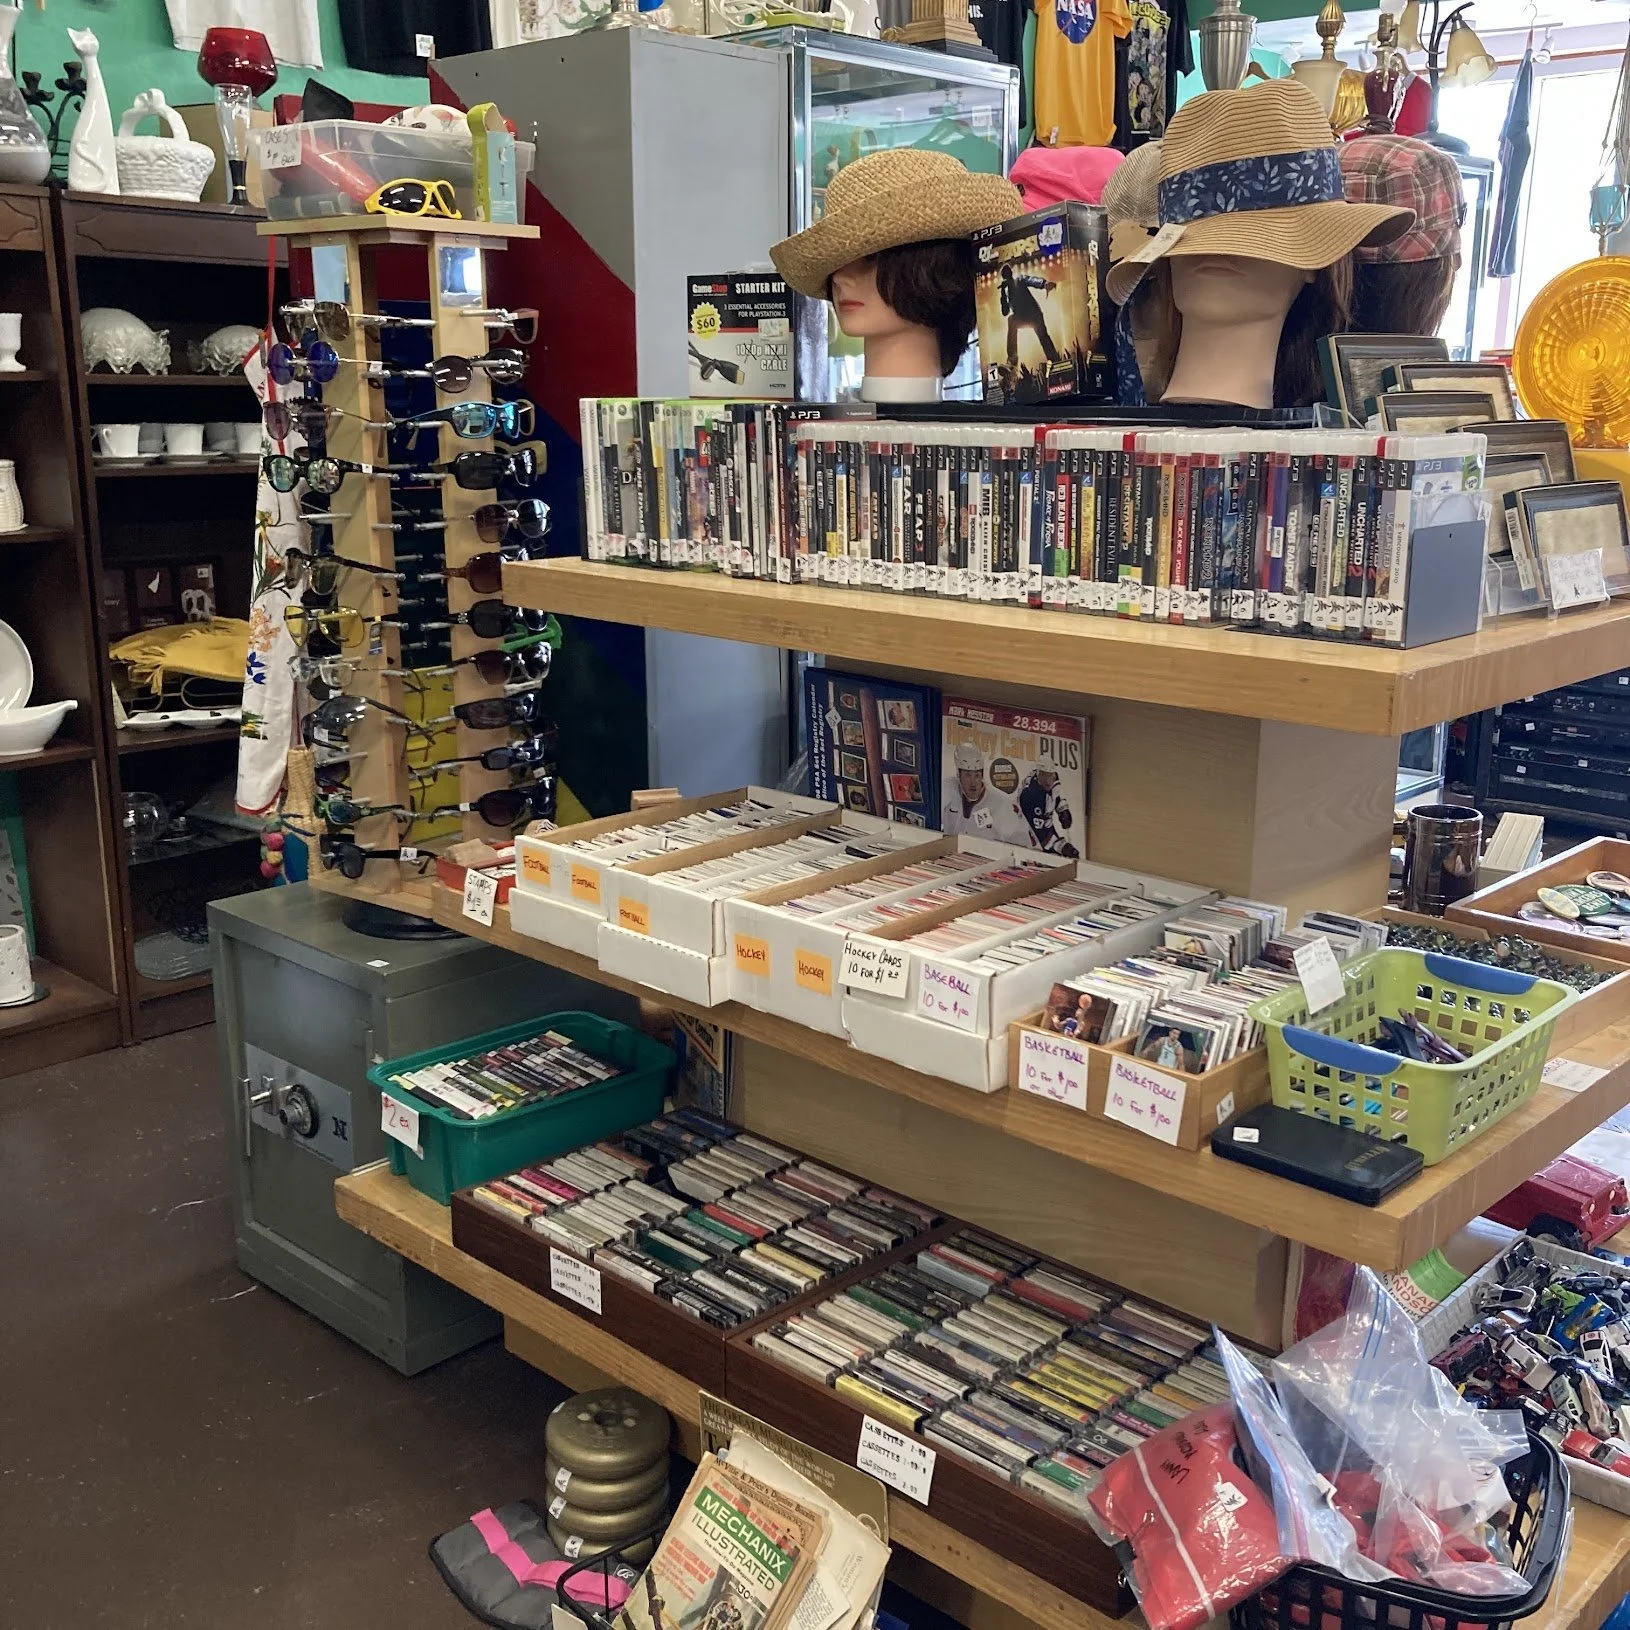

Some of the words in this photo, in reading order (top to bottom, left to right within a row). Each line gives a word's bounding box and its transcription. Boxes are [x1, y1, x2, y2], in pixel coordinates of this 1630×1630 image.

[1057, 0, 1094, 20] NASA
[980, 225, 1002, 239] PS3
[692, 284, 727, 293] GameStop
[735, 283, 770, 294] STARTER
[771, 282, 786, 293] KIT
[697, 317, 715, 330] $60
[760, 360, 787, 371] CABLE
[1049, 384, 1072, 394] KONAMI
[798, 411, 820, 420] PS3
[1400, 462, 1408, 487] PS3
[1423, 461, 1442, 471] PS3
[982, 489, 990, 516] MIB
[1122, 484, 1130, 540] RESISTANCE
[1337, 473, 1348, 537] UNCHARTED
[915, 493, 923, 541] FEAR
[1108, 497, 1117, 542] RESIDENT
[1286, 510, 1297, 543] TOMB
[1134, 534, 1138, 544] OF
[1311, 515, 1320, 567] GENESIS
[1354, 502, 1366, 565] UNCHARTED
[1383, 512, 1394, 568] UNCHARTED
[1107, 545, 1116, 565] EVIL
[1122, 542, 1128, 550] 2
[1395, 531, 1403, 566] vancouver
[1201, 571, 1212, 580] 2
[1284, 545, 1295, 587] RAIDER
[1349, 566, 1363, 577] 2
[1013, 715, 1057, 733] 28,394
[812, 723, 820, 755] Registry
[1000, 730, 1036, 761] Card
[1039, 737, 1078, 770] PLUS
[523, 855, 549, 874] FOOTBALL
[468, 874, 492, 895] STAMPS
[572, 874, 596, 890] FOOTBALL
[620, 909, 645, 926] FOOTBALL
[736, 944, 765, 961] HOCKEY
[844, 942, 877, 962] HOCKEY
[879, 949, 902, 968] CARDS
[799, 960, 824, 981] HOCKEY
[848, 961, 858, 973] 10
[860, 966, 874, 980] FOR
[923, 964, 971, 996] BASEBALL
[922, 991, 934, 1008] 10
[1024, 1036, 1085, 1065] BASKETBALL
[1025, 1063, 1036, 1078] 10
[1115, 1063, 1177, 1101] BASKETBALL
[1112, 1092, 1124, 1107] 10
[704, 1401, 720, 1415] THE
[723, 1409, 756, 1432] GREAT
[704, 1417, 733, 1436] GREATES
[865, 1422, 905, 1447] CASSETTES
[861, 1441, 901, 1462] CASSETTES
[806, 1461, 836, 1481] WORLD'S
[860, 1457, 897, 1480] CASSETTES
[748, 1475, 771, 1495] Price's
[701, 1494, 786, 1576] MECHANIX
[692, 1512, 775, 1591] ILLUSTRATED
[704, 1538, 712, 1548] The
[736, 1567, 754, 1586] Magazine
